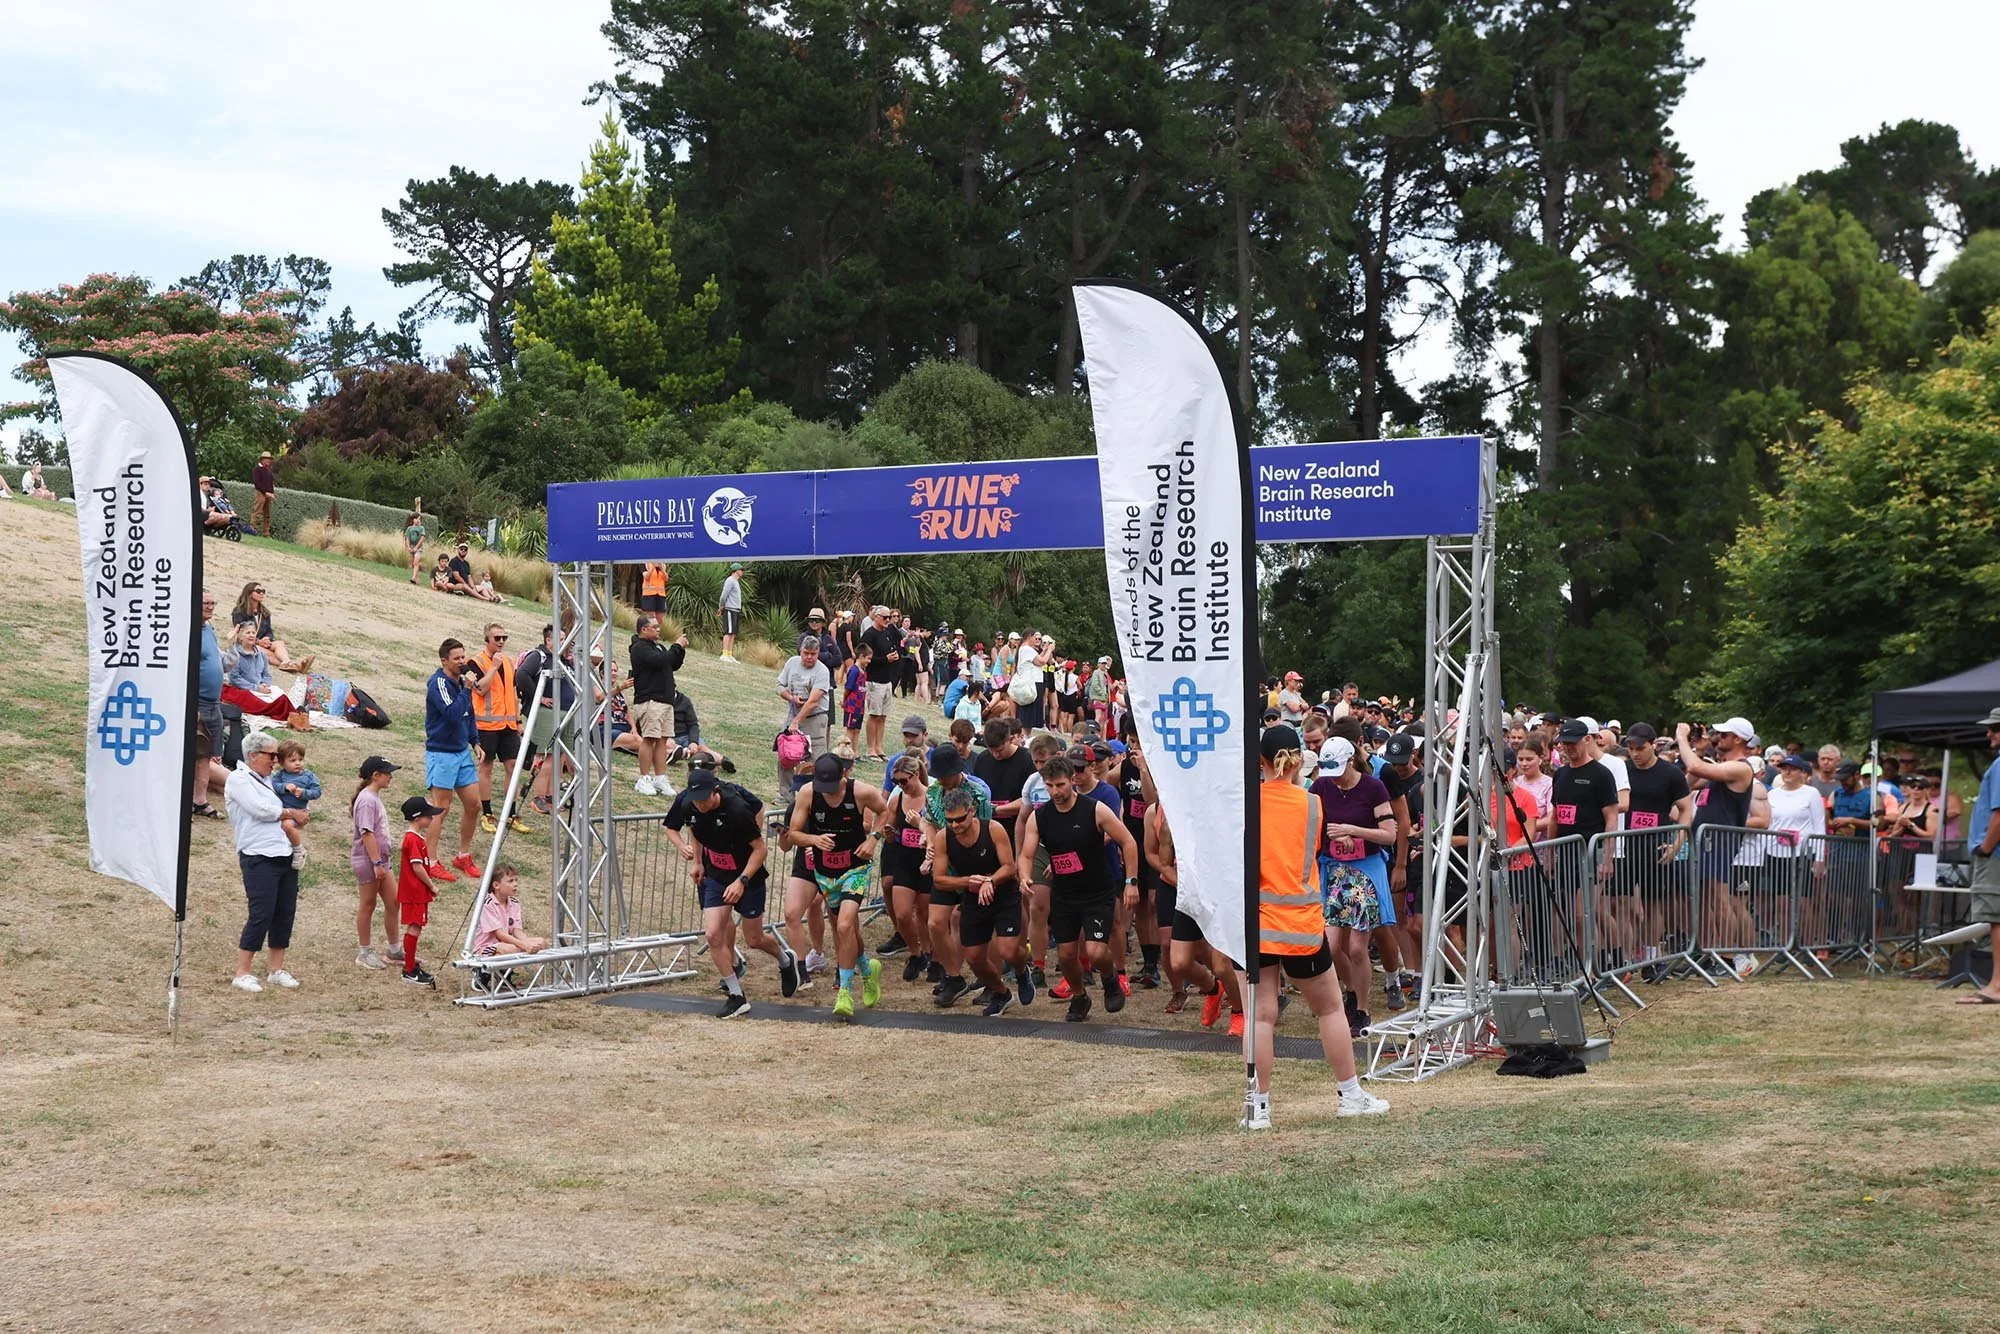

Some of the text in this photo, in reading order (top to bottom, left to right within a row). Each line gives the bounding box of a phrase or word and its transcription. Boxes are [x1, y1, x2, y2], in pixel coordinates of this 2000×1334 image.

[1260, 459, 1380, 481] New Zealand
[922, 474, 1003, 507] VINE
[1260, 480, 1394, 502] Brain Research
[597, 498, 696, 526] PEGASUS BAY
[927, 507, 1003, 540] RUN
[1260, 504, 1332, 523] Institute
[597, 531, 695, 542] FINE NORTH CANTERBURY WINE
[1170, 440, 1197, 662] Brain Research
[93, 486, 120, 668] New Zealand
[119, 463, 145, 668] Brain Research
[1142, 464, 1171, 662] New Zealand
[1121, 505, 1145, 659] Friends of the
[146, 557, 172, 669] Institute
[1203, 541, 1230, 661] Institute
[1635, 816, 1654, 827] 452
[826, 855, 845, 865] 481
[1054, 859, 1072, 870] 359
